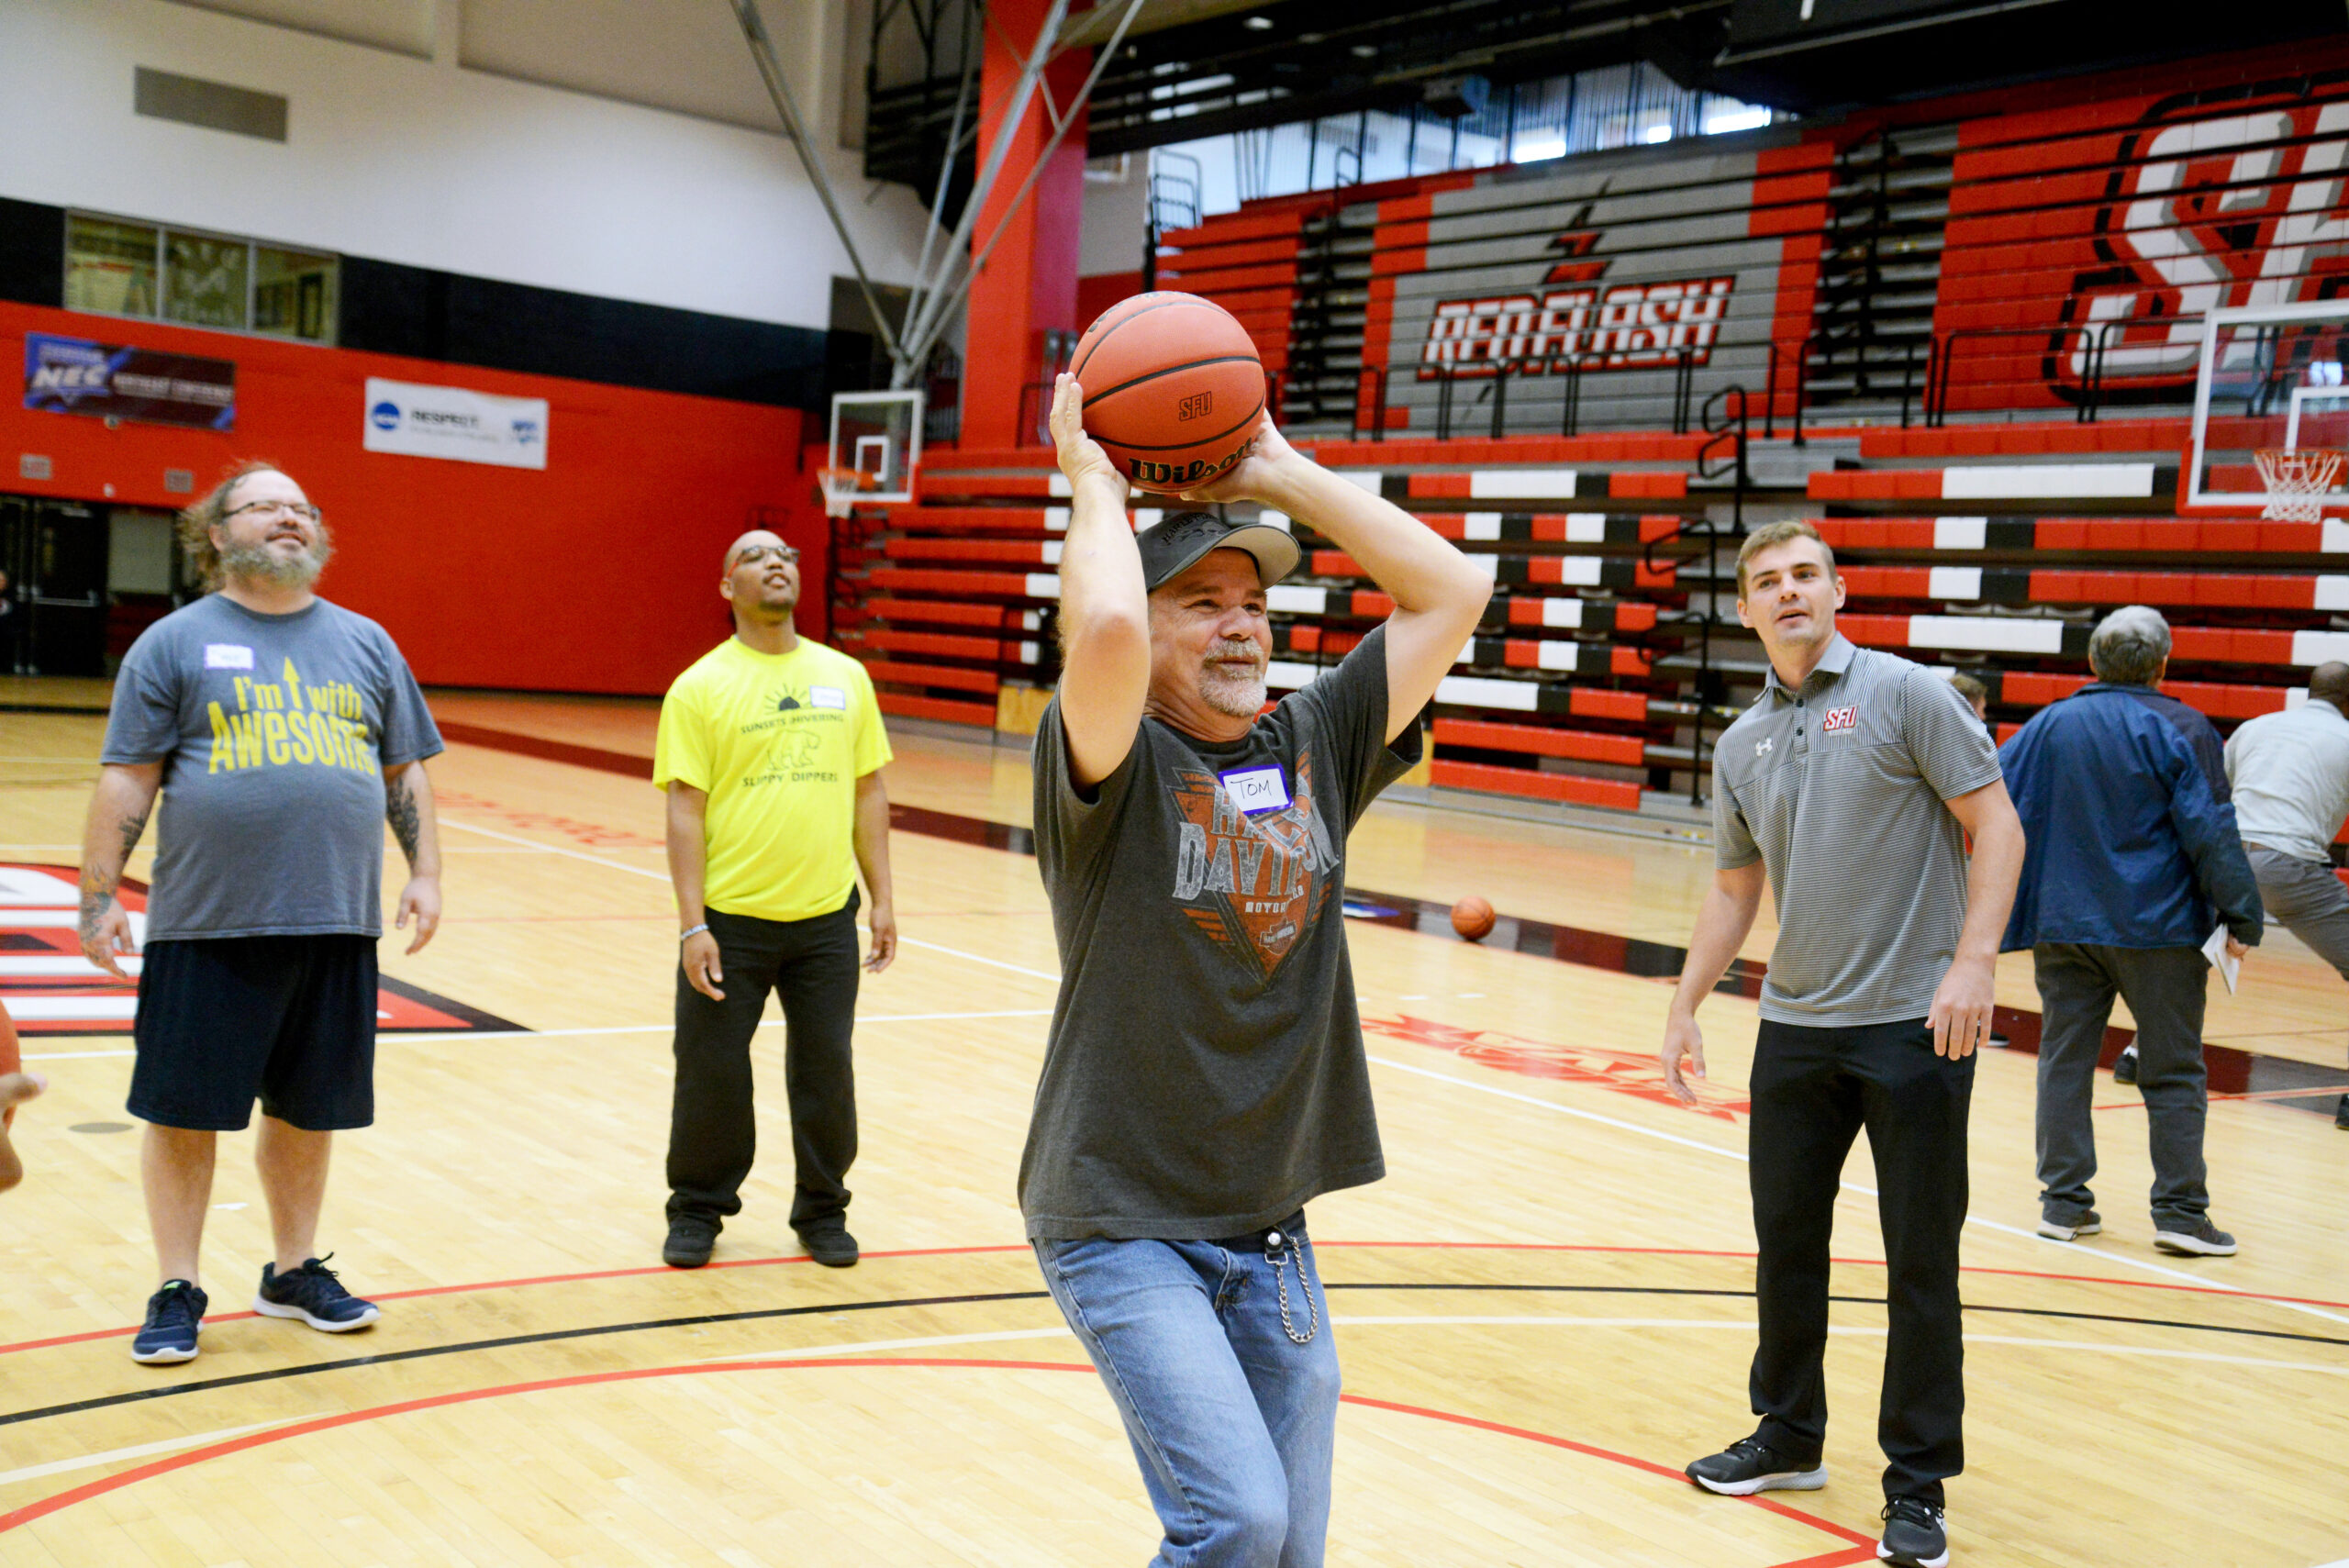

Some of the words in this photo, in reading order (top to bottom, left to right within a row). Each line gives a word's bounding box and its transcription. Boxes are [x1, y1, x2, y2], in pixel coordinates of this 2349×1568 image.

[1179, 391, 1212, 422] SFU
[233, 676, 284, 712] I'm
[306, 679, 362, 720] with
[1823, 706, 1858, 731] SFU
[1230, 777, 1273, 799] TOM
